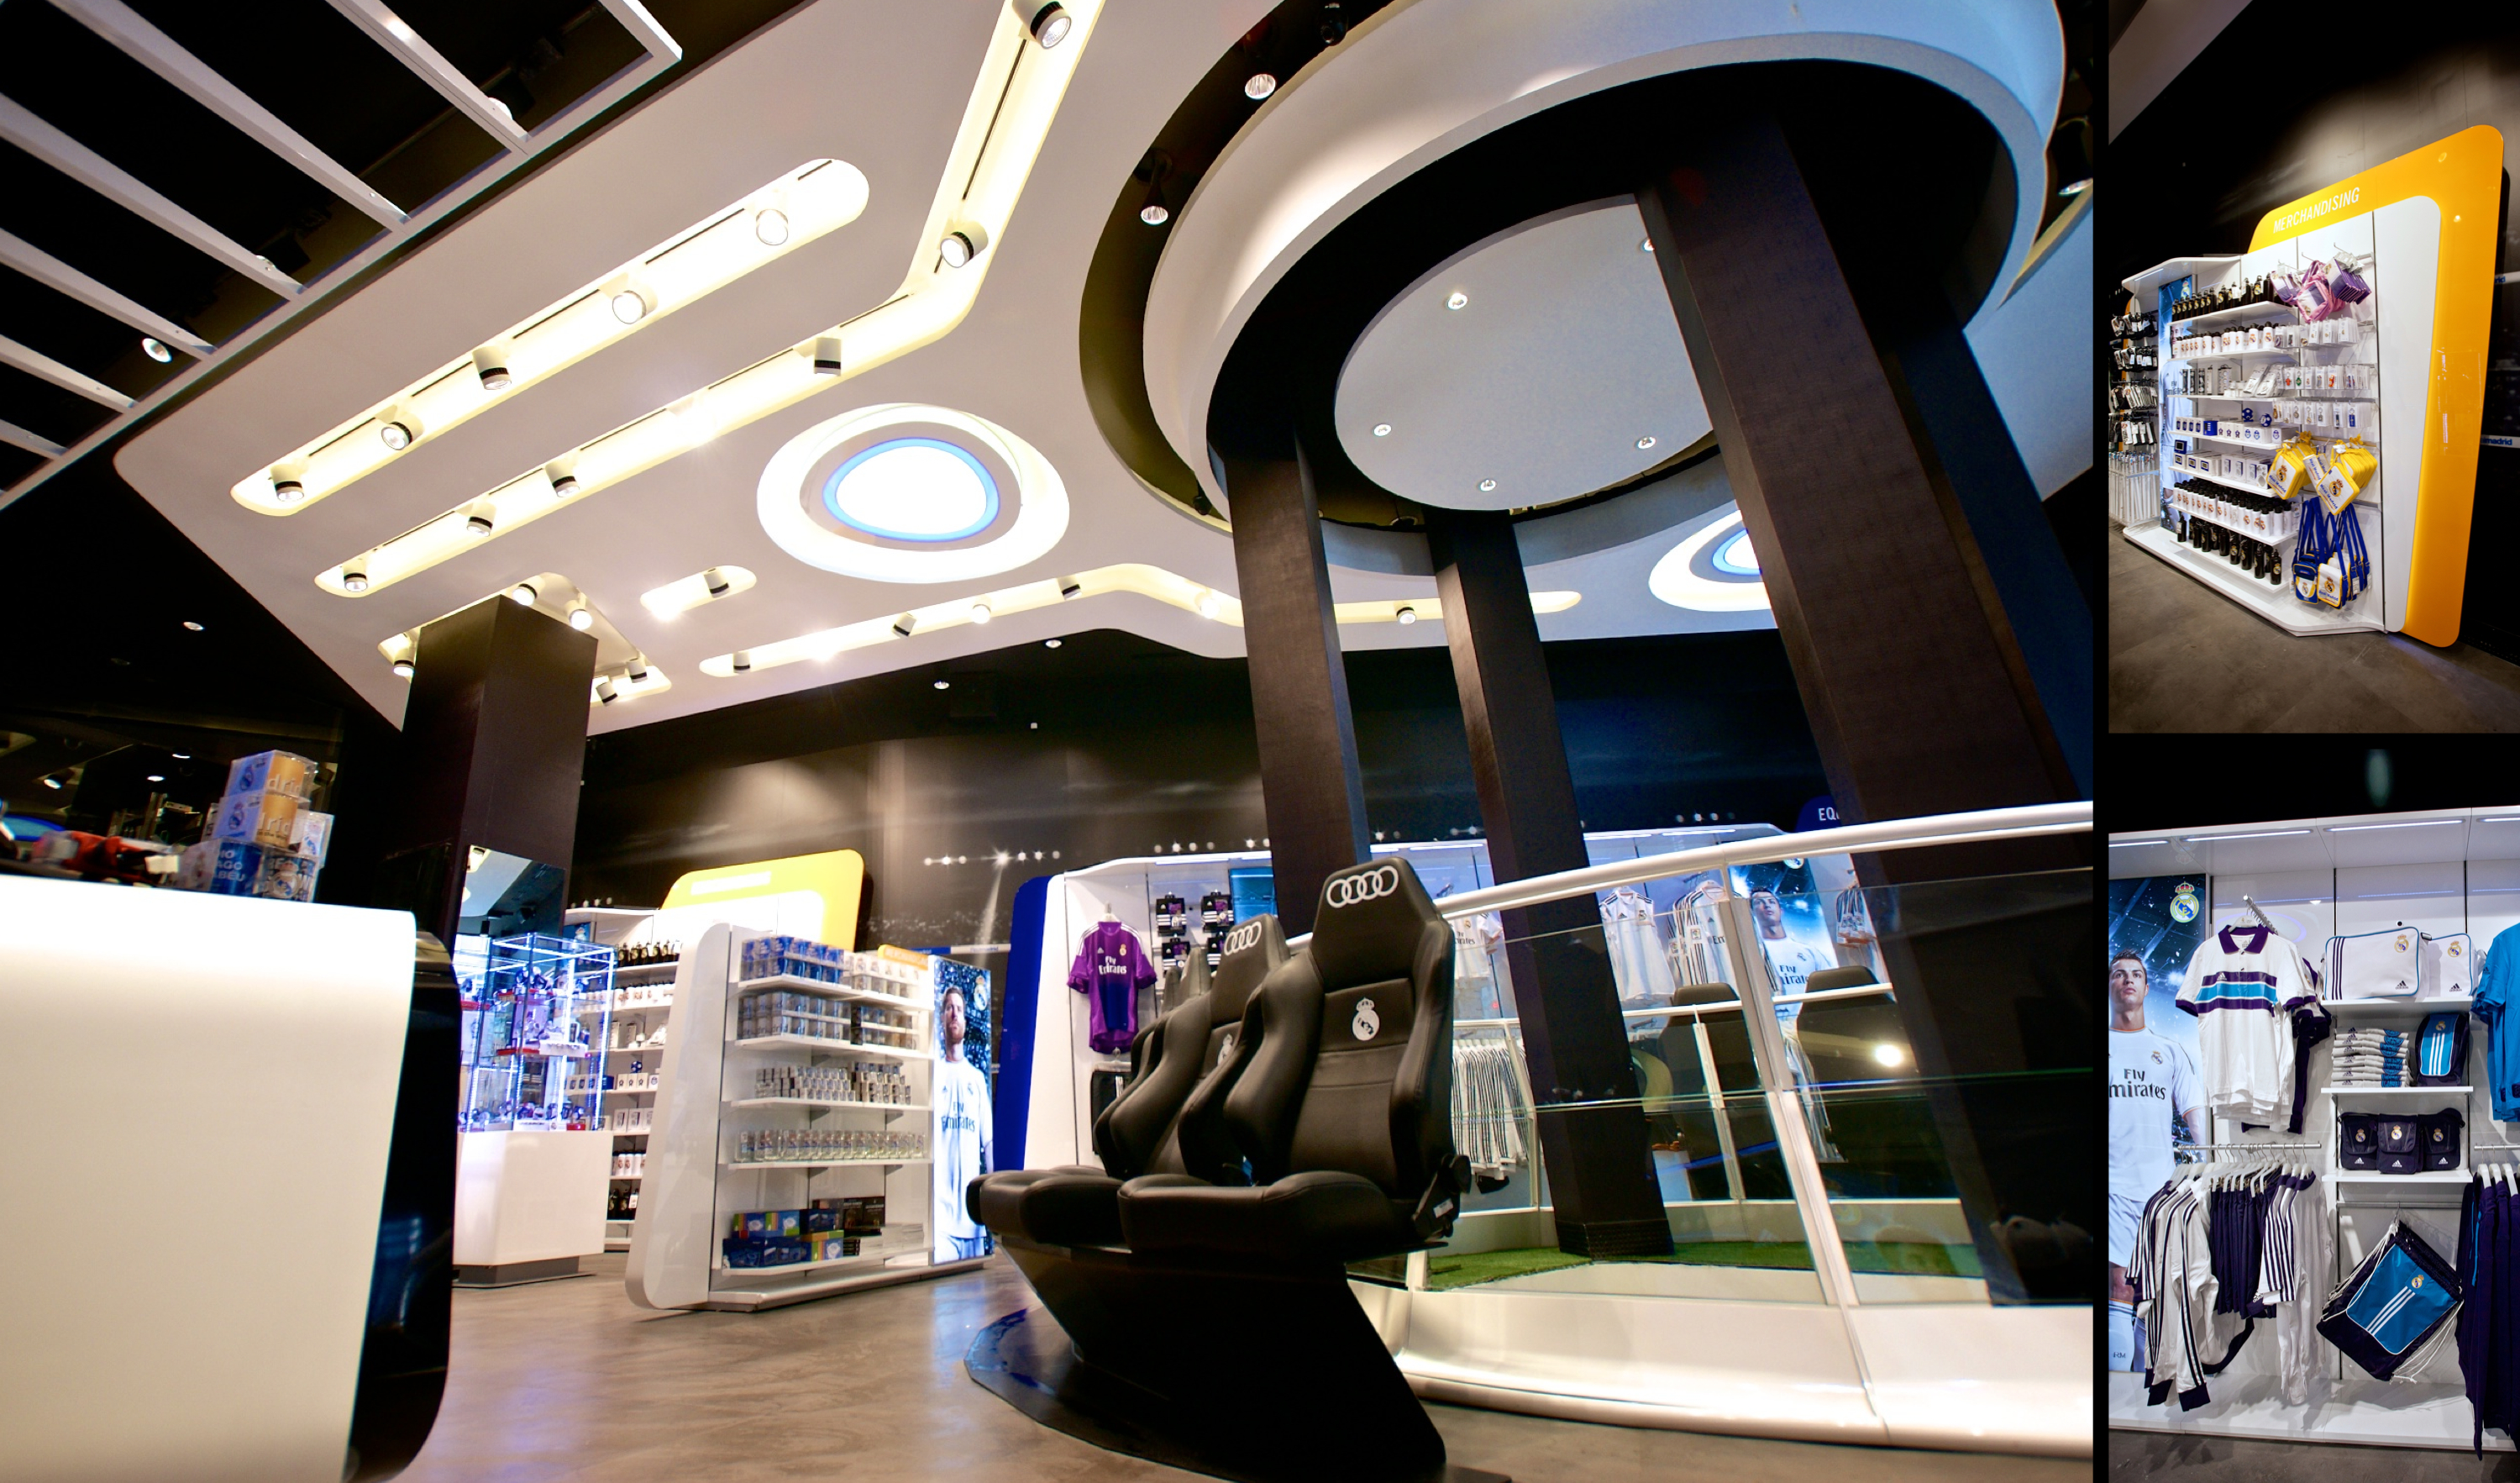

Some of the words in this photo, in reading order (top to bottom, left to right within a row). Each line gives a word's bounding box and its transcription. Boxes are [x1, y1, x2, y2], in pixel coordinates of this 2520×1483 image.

[2273, 187, 2360, 234] MERCHANDISING
[1779, 965, 1796, 974] Fly
[2124, 1068, 2145, 1082] Fly
[2108, 1081, 2166, 1101] mirates
